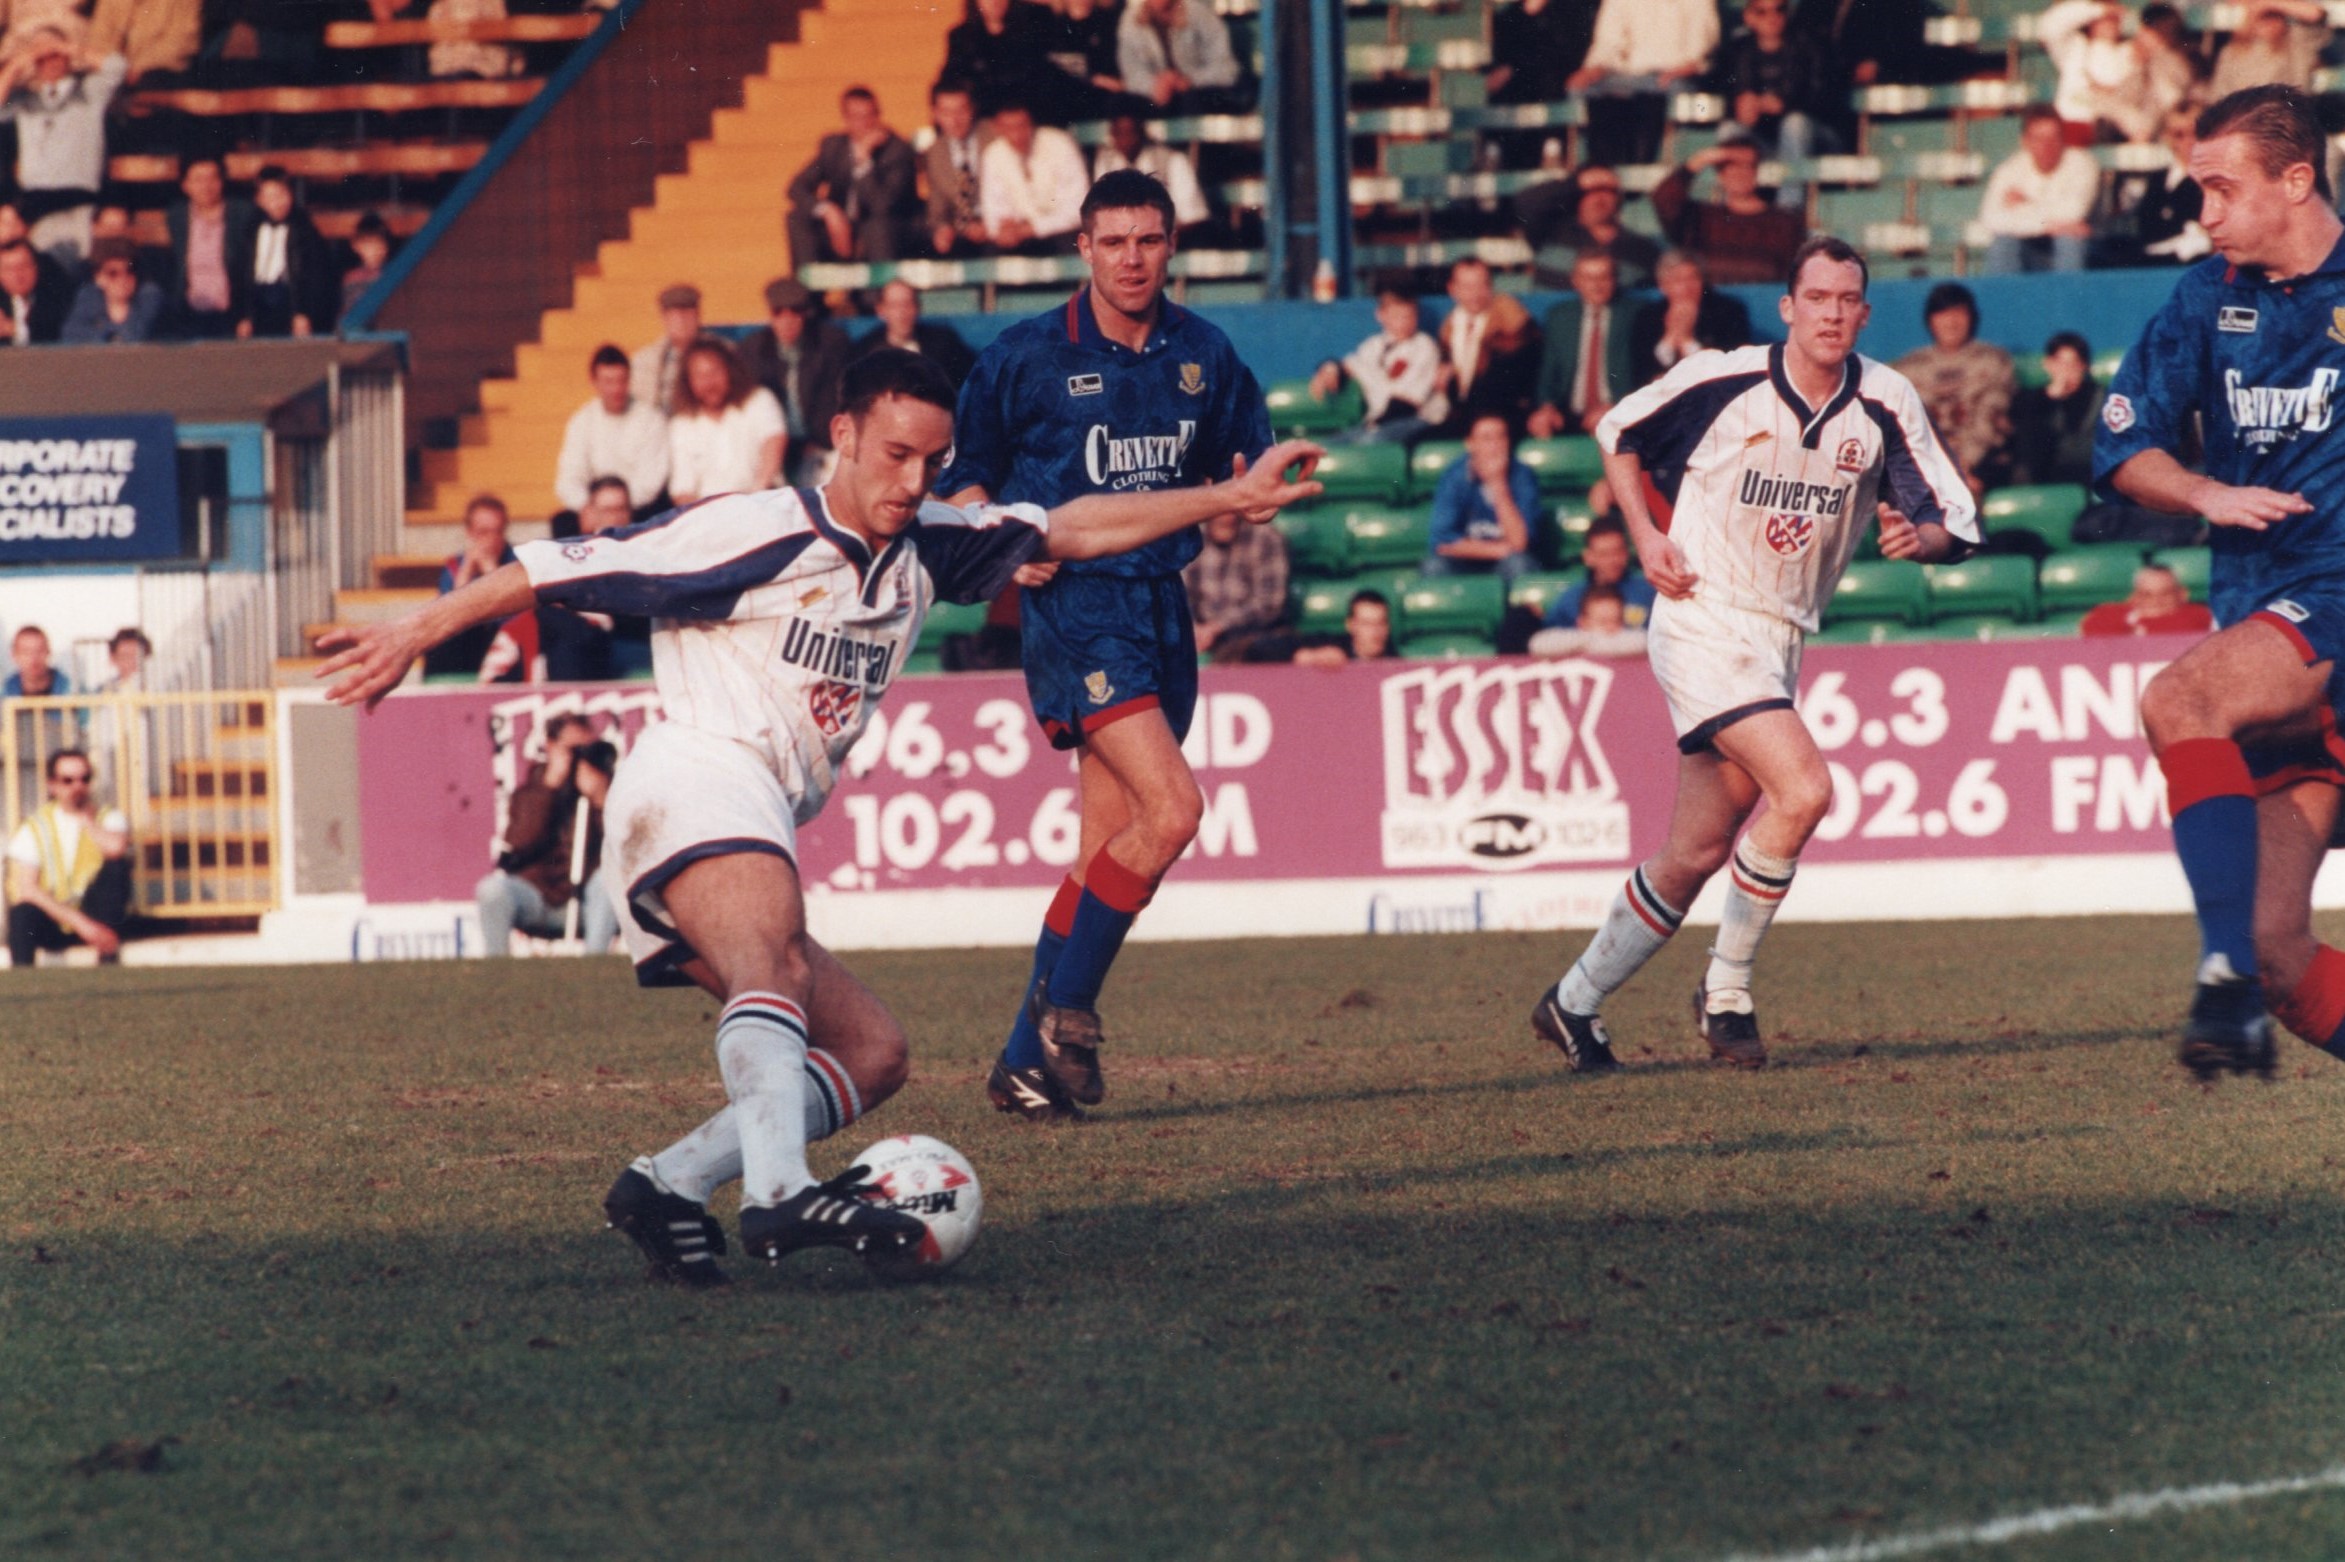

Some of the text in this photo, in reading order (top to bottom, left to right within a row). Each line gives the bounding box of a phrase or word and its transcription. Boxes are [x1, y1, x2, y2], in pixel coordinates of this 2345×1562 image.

[1112, 470, 1170, 490] CLOTHING
[1398, 671, 1606, 800] ESSEX
[1795, 667, 1949, 749] 6.3
[844, 786, 1081, 870] 102.6
[1462, 819, 1541, 852] FM
[1814, 753, 2172, 841] 02.6 FM
